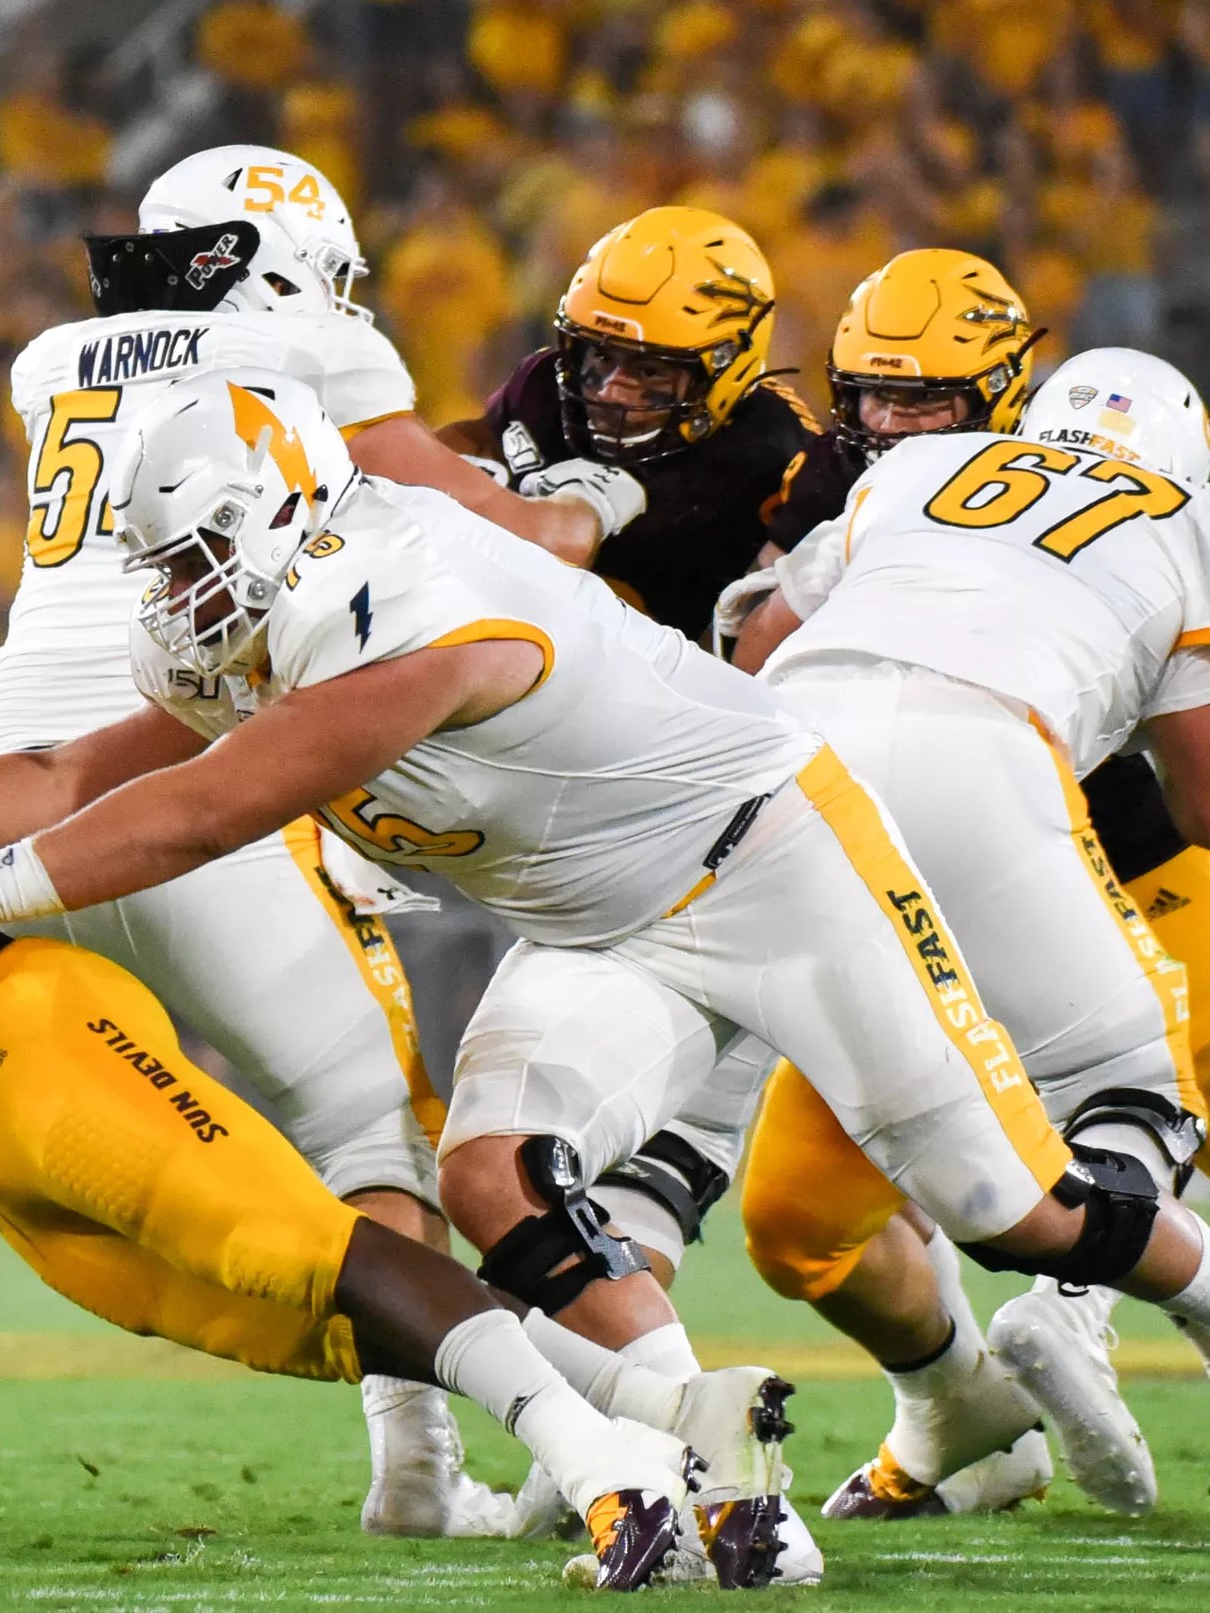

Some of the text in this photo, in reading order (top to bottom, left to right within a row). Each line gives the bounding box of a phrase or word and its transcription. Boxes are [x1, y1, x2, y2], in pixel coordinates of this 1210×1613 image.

[244, 166, 326, 221] 54
[78, 328, 209, 387] WARNOCK
[27, 385, 123, 568] 5
[924, 440, 1193, 564] 67
[886, 888, 1022, 1094] FLASHFAST
[86, 1018, 229, 1143] SUN DEVILS
